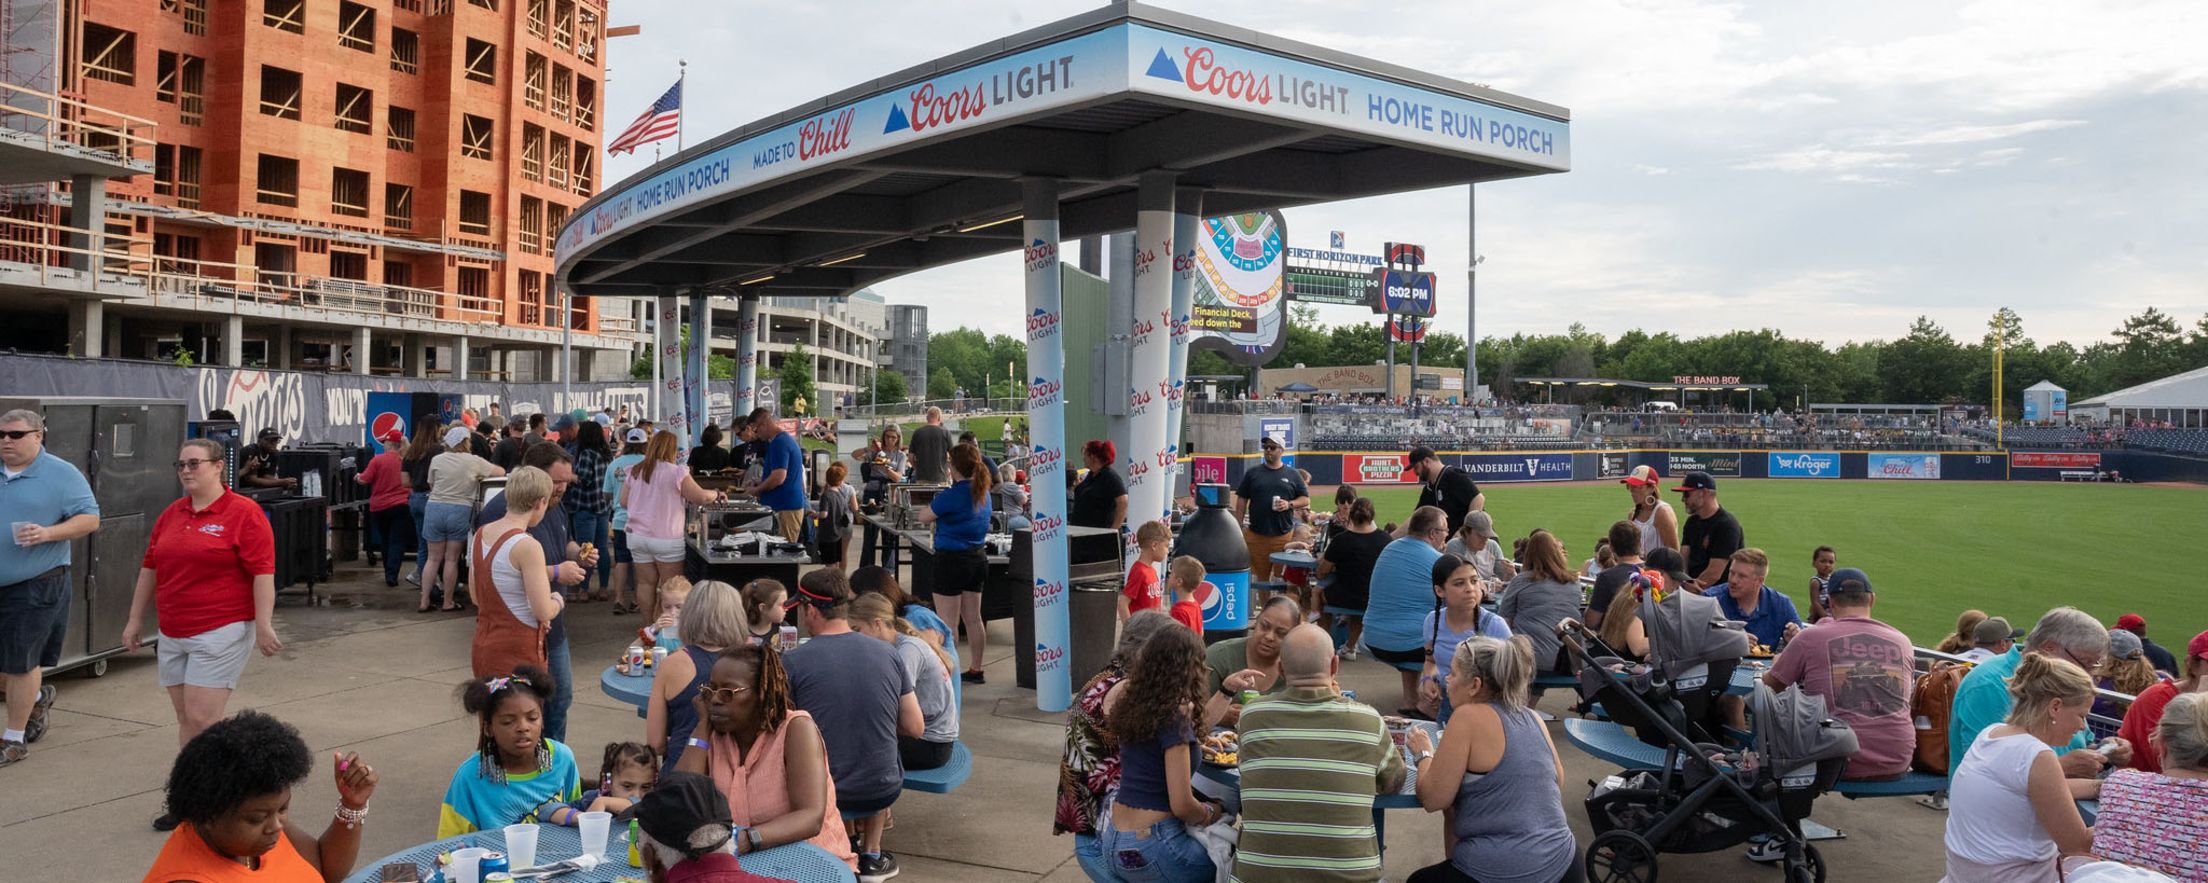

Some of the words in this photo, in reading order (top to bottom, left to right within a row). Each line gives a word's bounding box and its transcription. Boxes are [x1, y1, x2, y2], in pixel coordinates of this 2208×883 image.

[1184, 46, 1273, 105] Coors
[1278, 74, 1349, 114] LIGHT
[911, 82, 986, 132] Coors
[993, 55, 1074, 106] LIGHT
[1368, 94, 1433, 132] HOME
[1441, 110, 1482, 142] RUN
[1490, 119, 1553, 156] PORCH
[753, 145, 780, 170] MADE
[782, 141, 796, 160] TO
[799, 106, 855, 161] Chill
[637, 185, 662, 213] HOME
[664, 176, 685, 201] RUN
[689, 158, 729, 194] PORCH
[1030, 256, 1056, 272] LIGHT
[1287, 247, 1315, 259] FIRST
[1316, 250, 1358, 263] HORIZON
[1360, 255, 1383, 266] PARK
[1388, 286, 1411, 298] 6:02
[1412, 288, 1428, 300] PM
[1195, 306, 1230, 317] Financial
[1231, 309, 1253, 320] Deck,
[1205, 318, 1228, 328] down
[1229, 319, 1242, 328] the
[1030, 325, 1058, 341] LIGHT
[1334, 368, 1356, 379] BAND
[1358, 371, 1376, 386] BOX
[1673, 375, 1691, 384] THE
[1694, 375, 1720, 384] BAND
[1722, 375, 1740, 384] BOX
[326, 388, 371, 426] YOU'R
[553, 391, 602, 414] NSHVILLE
[1031, 394, 1058, 409] LIGHT
[1464, 463, 1524, 473] VANDERBILT
[1540, 463, 1571, 472] HEALTH
[1794, 455, 1831, 475] Kroger
[1975, 455, 1991, 464] 310
[1032, 463, 1057, 476] LIGHT
[1032, 514, 1062, 533] oors
[1034, 581, 1063, 599] oors
[1225, 583, 1236, 620] pepsi
[1035, 646, 1063, 662] oors
[1832, 637, 1901, 665] Jeep
